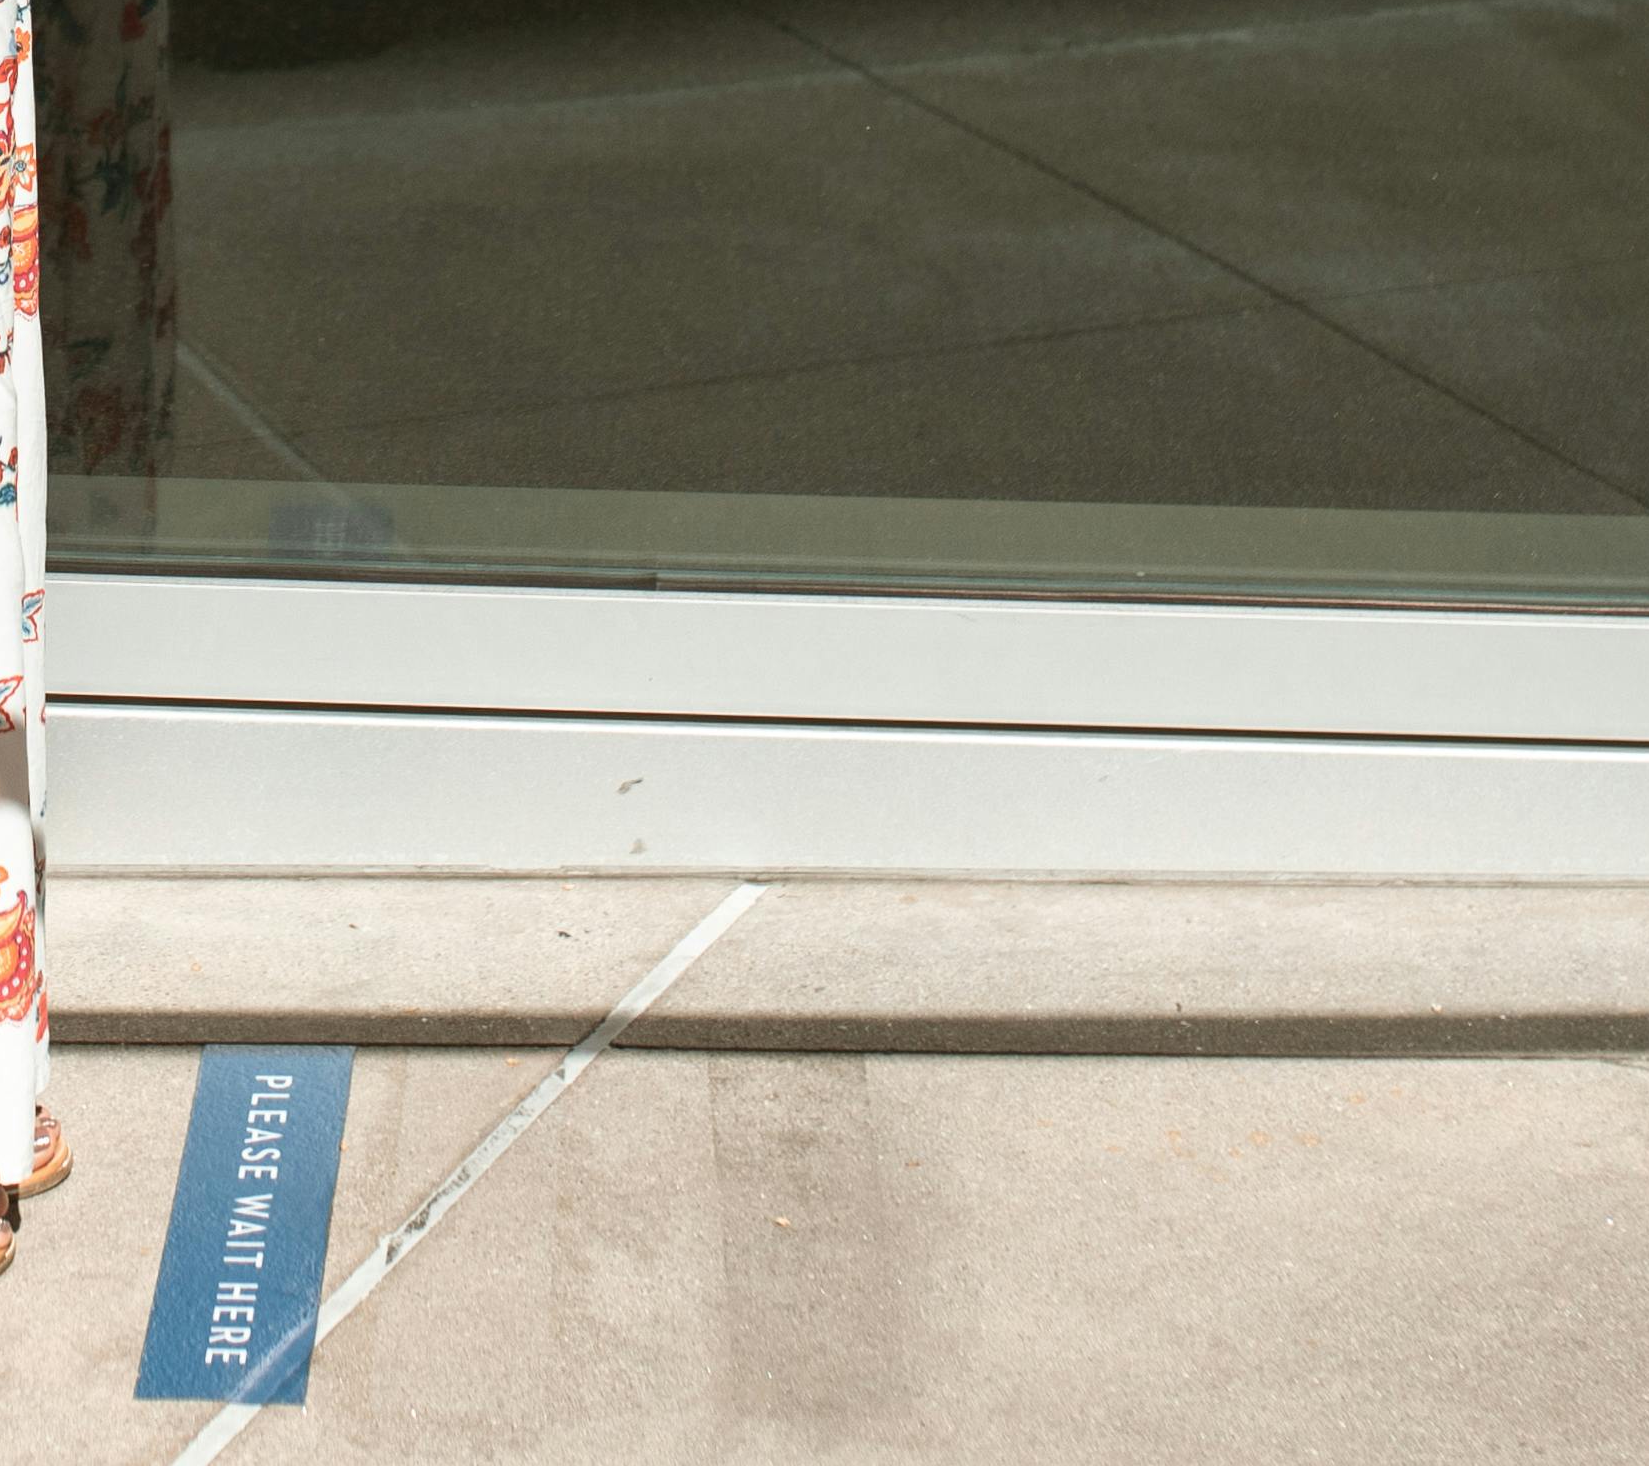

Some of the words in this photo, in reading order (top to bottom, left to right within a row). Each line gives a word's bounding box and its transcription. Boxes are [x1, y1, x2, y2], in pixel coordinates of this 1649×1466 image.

[237, 1074, 293, 1180] PLEASE
[223, 1193, 274, 1269] WAIT
[205, 1282, 259, 1366] HERE
